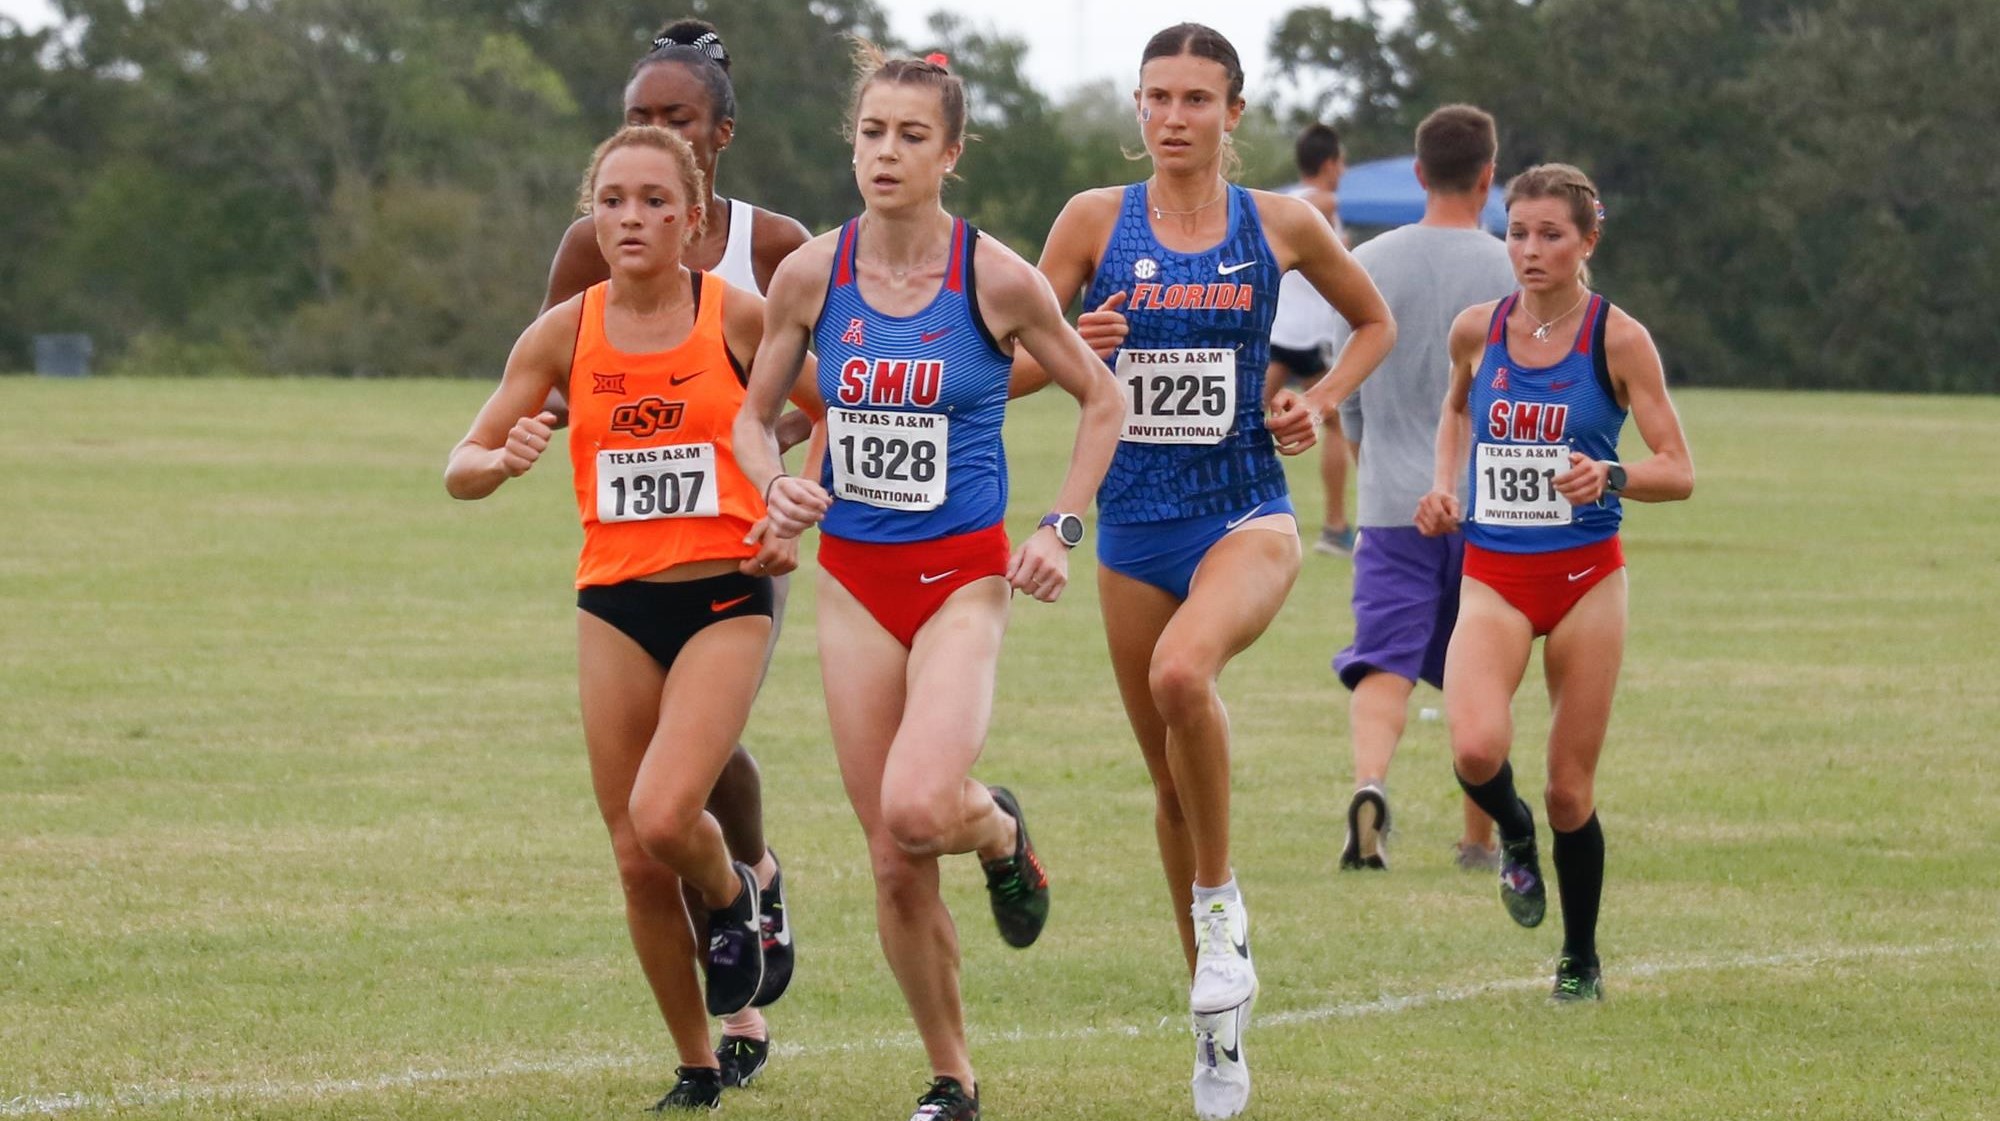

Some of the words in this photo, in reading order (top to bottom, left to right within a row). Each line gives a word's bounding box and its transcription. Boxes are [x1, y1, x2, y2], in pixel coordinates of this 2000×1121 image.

[1134, 258, 1157, 279] SEC
[1127, 282, 1253, 311] FLORIDA
[1128, 352, 1180, 364] TEXAS
[1185, 352, 1223, 364] A&M
[837, 357, 944, 407] SMU
[1128, 375, 1226, 417] 1225
[610, 396, 686, 438] OSU
[840, 411, 890, 426] TEXAS
[895, 415, 934, 428] A&M
[1489, 399, 1568, 443] SMU
[1128, 425, 1223, 437] INVITATIONAL
[608, 451, 657, 465] TEXAS
[662, 447, 700, 461] A&M
[839, 435, 937, 482] 1328
[1484, 447, 1521, 458] TEXAS
[1525, 448, 1558, 458] A&M
[610, 470, 705, 516] 1307
[844, 482, 931, 504] INVITATIONAL
[1484, 466, 1557, 502] 1331
[1484, 508, 1560, 520] INVITATIONAL
